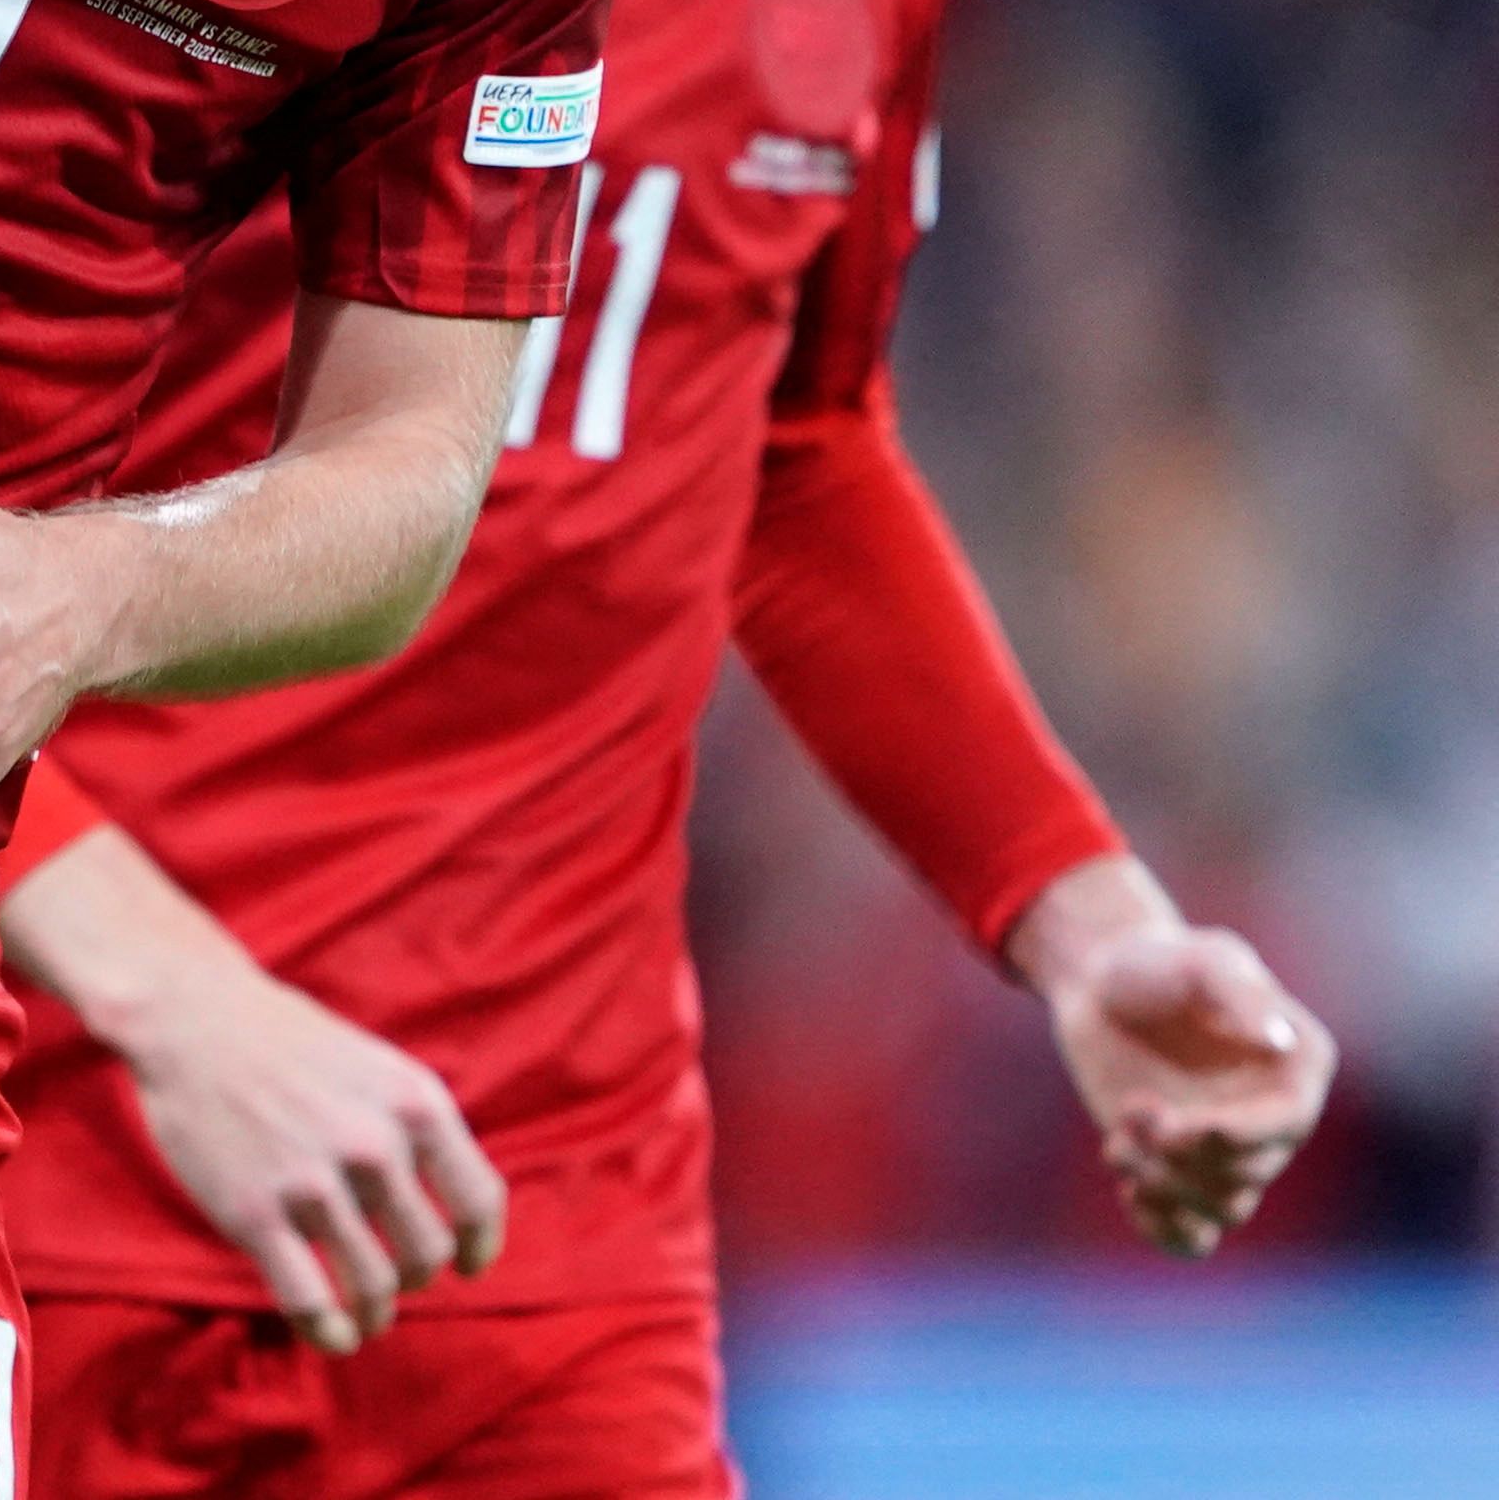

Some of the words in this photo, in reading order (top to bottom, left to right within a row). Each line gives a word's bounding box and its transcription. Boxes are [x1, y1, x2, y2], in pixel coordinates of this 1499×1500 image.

[117, 4, 188, 48] SEPTEMBER
[184, 37, 216, 62] 2022
[216, 25, 278, 57] FRANCE
[483, 82, 533, 101] UEFA
